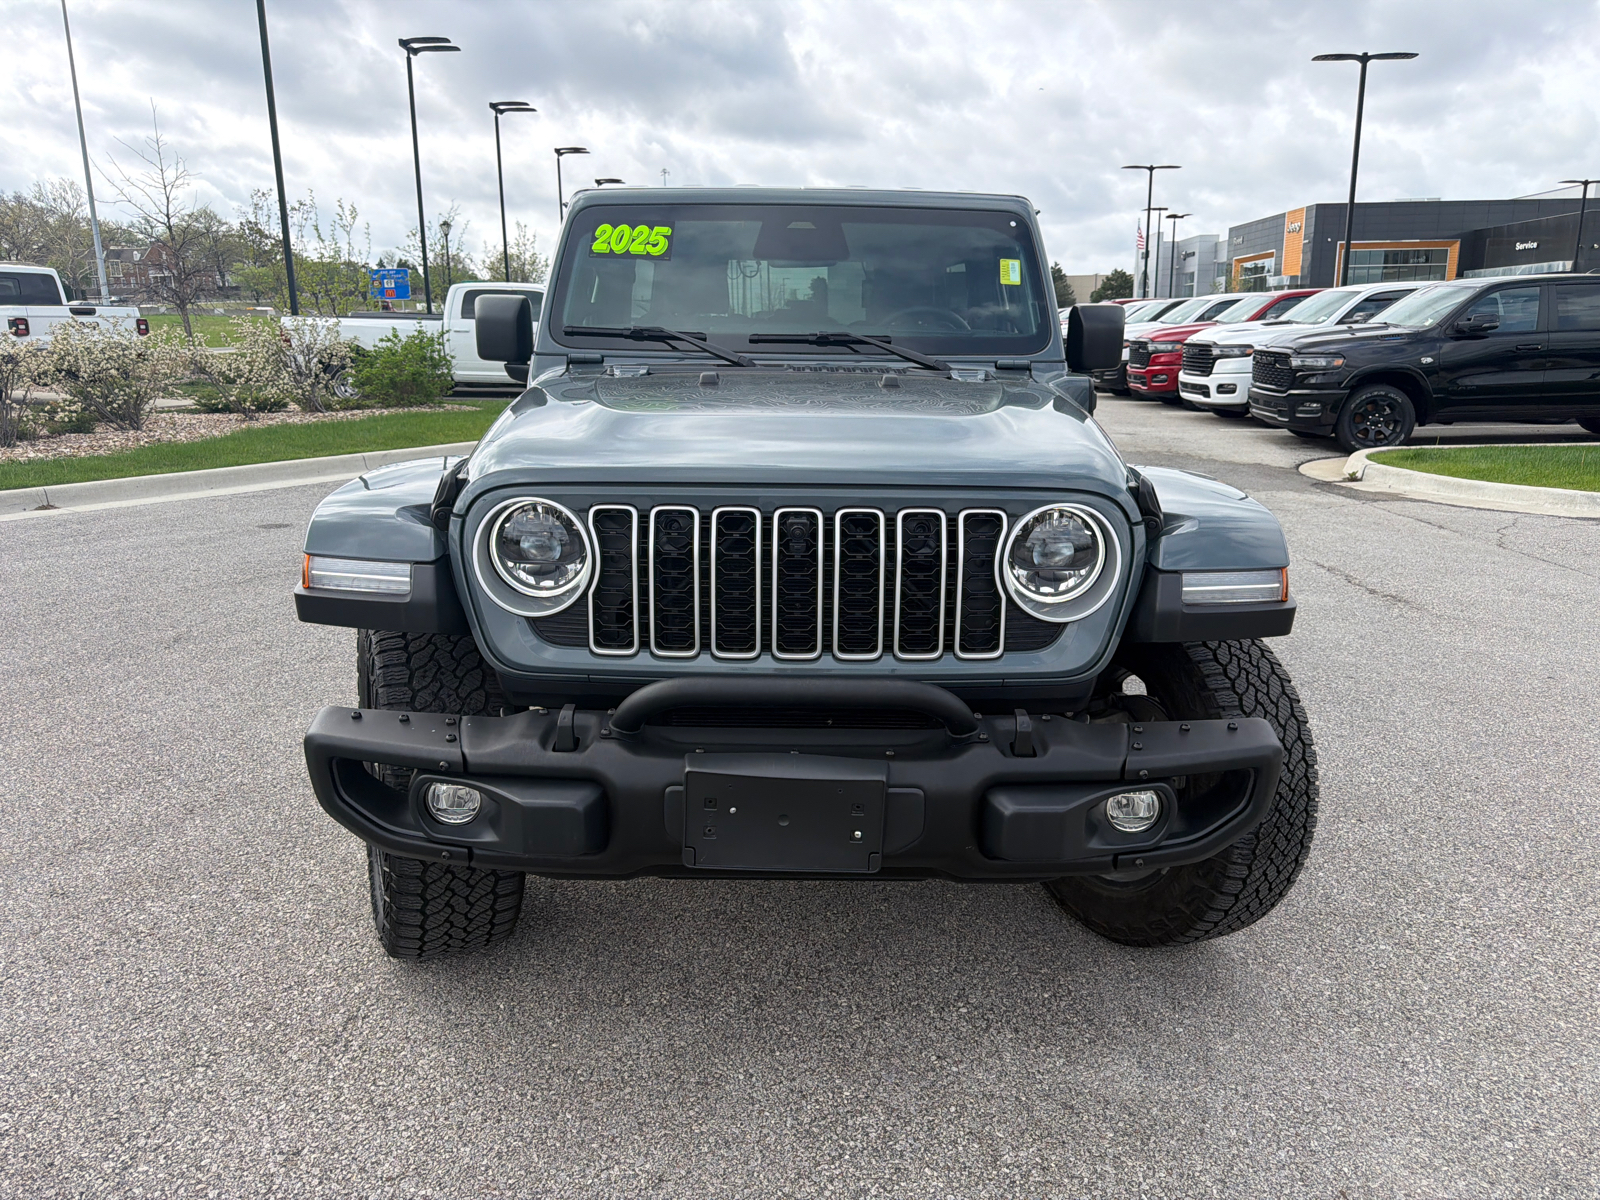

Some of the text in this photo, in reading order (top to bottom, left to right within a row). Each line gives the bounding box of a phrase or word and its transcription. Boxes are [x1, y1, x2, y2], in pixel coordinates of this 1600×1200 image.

[1286, 221, 1301, 234] Jeep
[592, 223, 672, 256] 2025
[1515, 241, 1538, 251] Service
